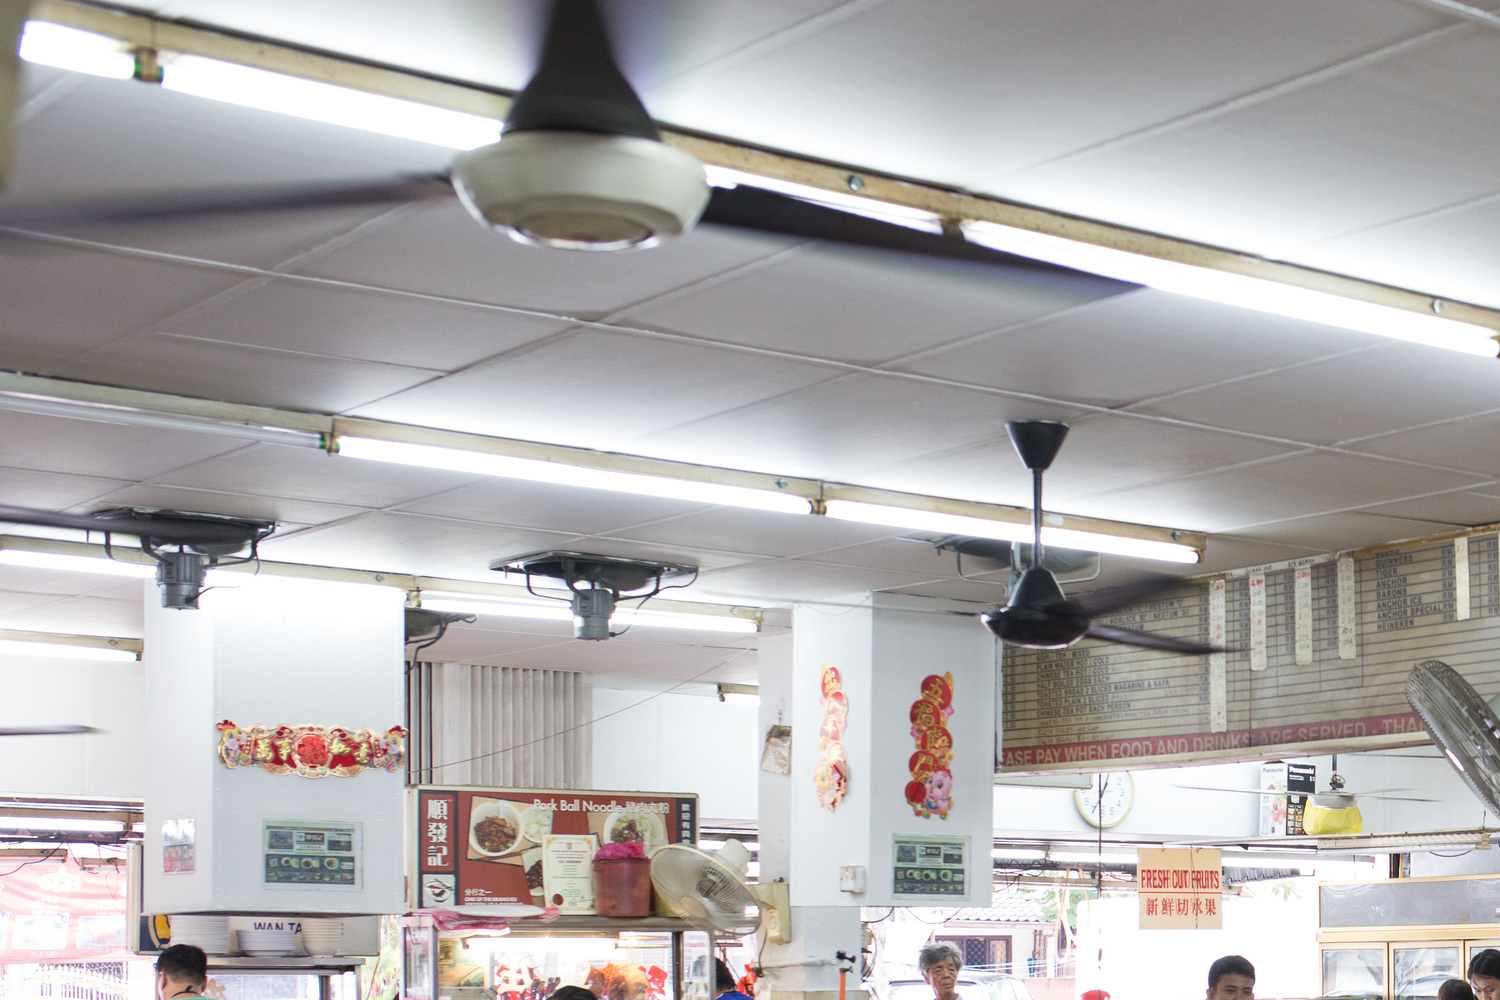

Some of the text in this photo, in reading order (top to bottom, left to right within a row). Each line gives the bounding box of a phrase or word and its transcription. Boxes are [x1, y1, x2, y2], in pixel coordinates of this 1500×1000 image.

[1375, 554, 1413, 568] GUINNESS
[1375, 567, 1398, 579] TIGER
[1376, 577, 1407, 590] ANCHOR
[1376, 588, 1407, 600] BARONS
[1377, 595, 1423, 611] ANCHOR ICE
[1377, 604, 1442, 621] ANCHOR SPECIAL
[1377, 619, 1415, 632] HEINEKEN
[1036, 748, 1061, 764] PAY
[1064, 744, 1107, 762] WHEN
[1111, 740, 1155, 759] FOOD
[1157, 736, 1192, 755] AND
[1193, 734, 1250, 752] DRINKS
[533, 799, 558, 813] Pork
[560, 799, 580, 813] Ball
[427, 799, 449, 867] 順發記
[1141, 869, 1219, 890] FRESH CUT FRUITS
[254, 922, 284, 931] WAN
